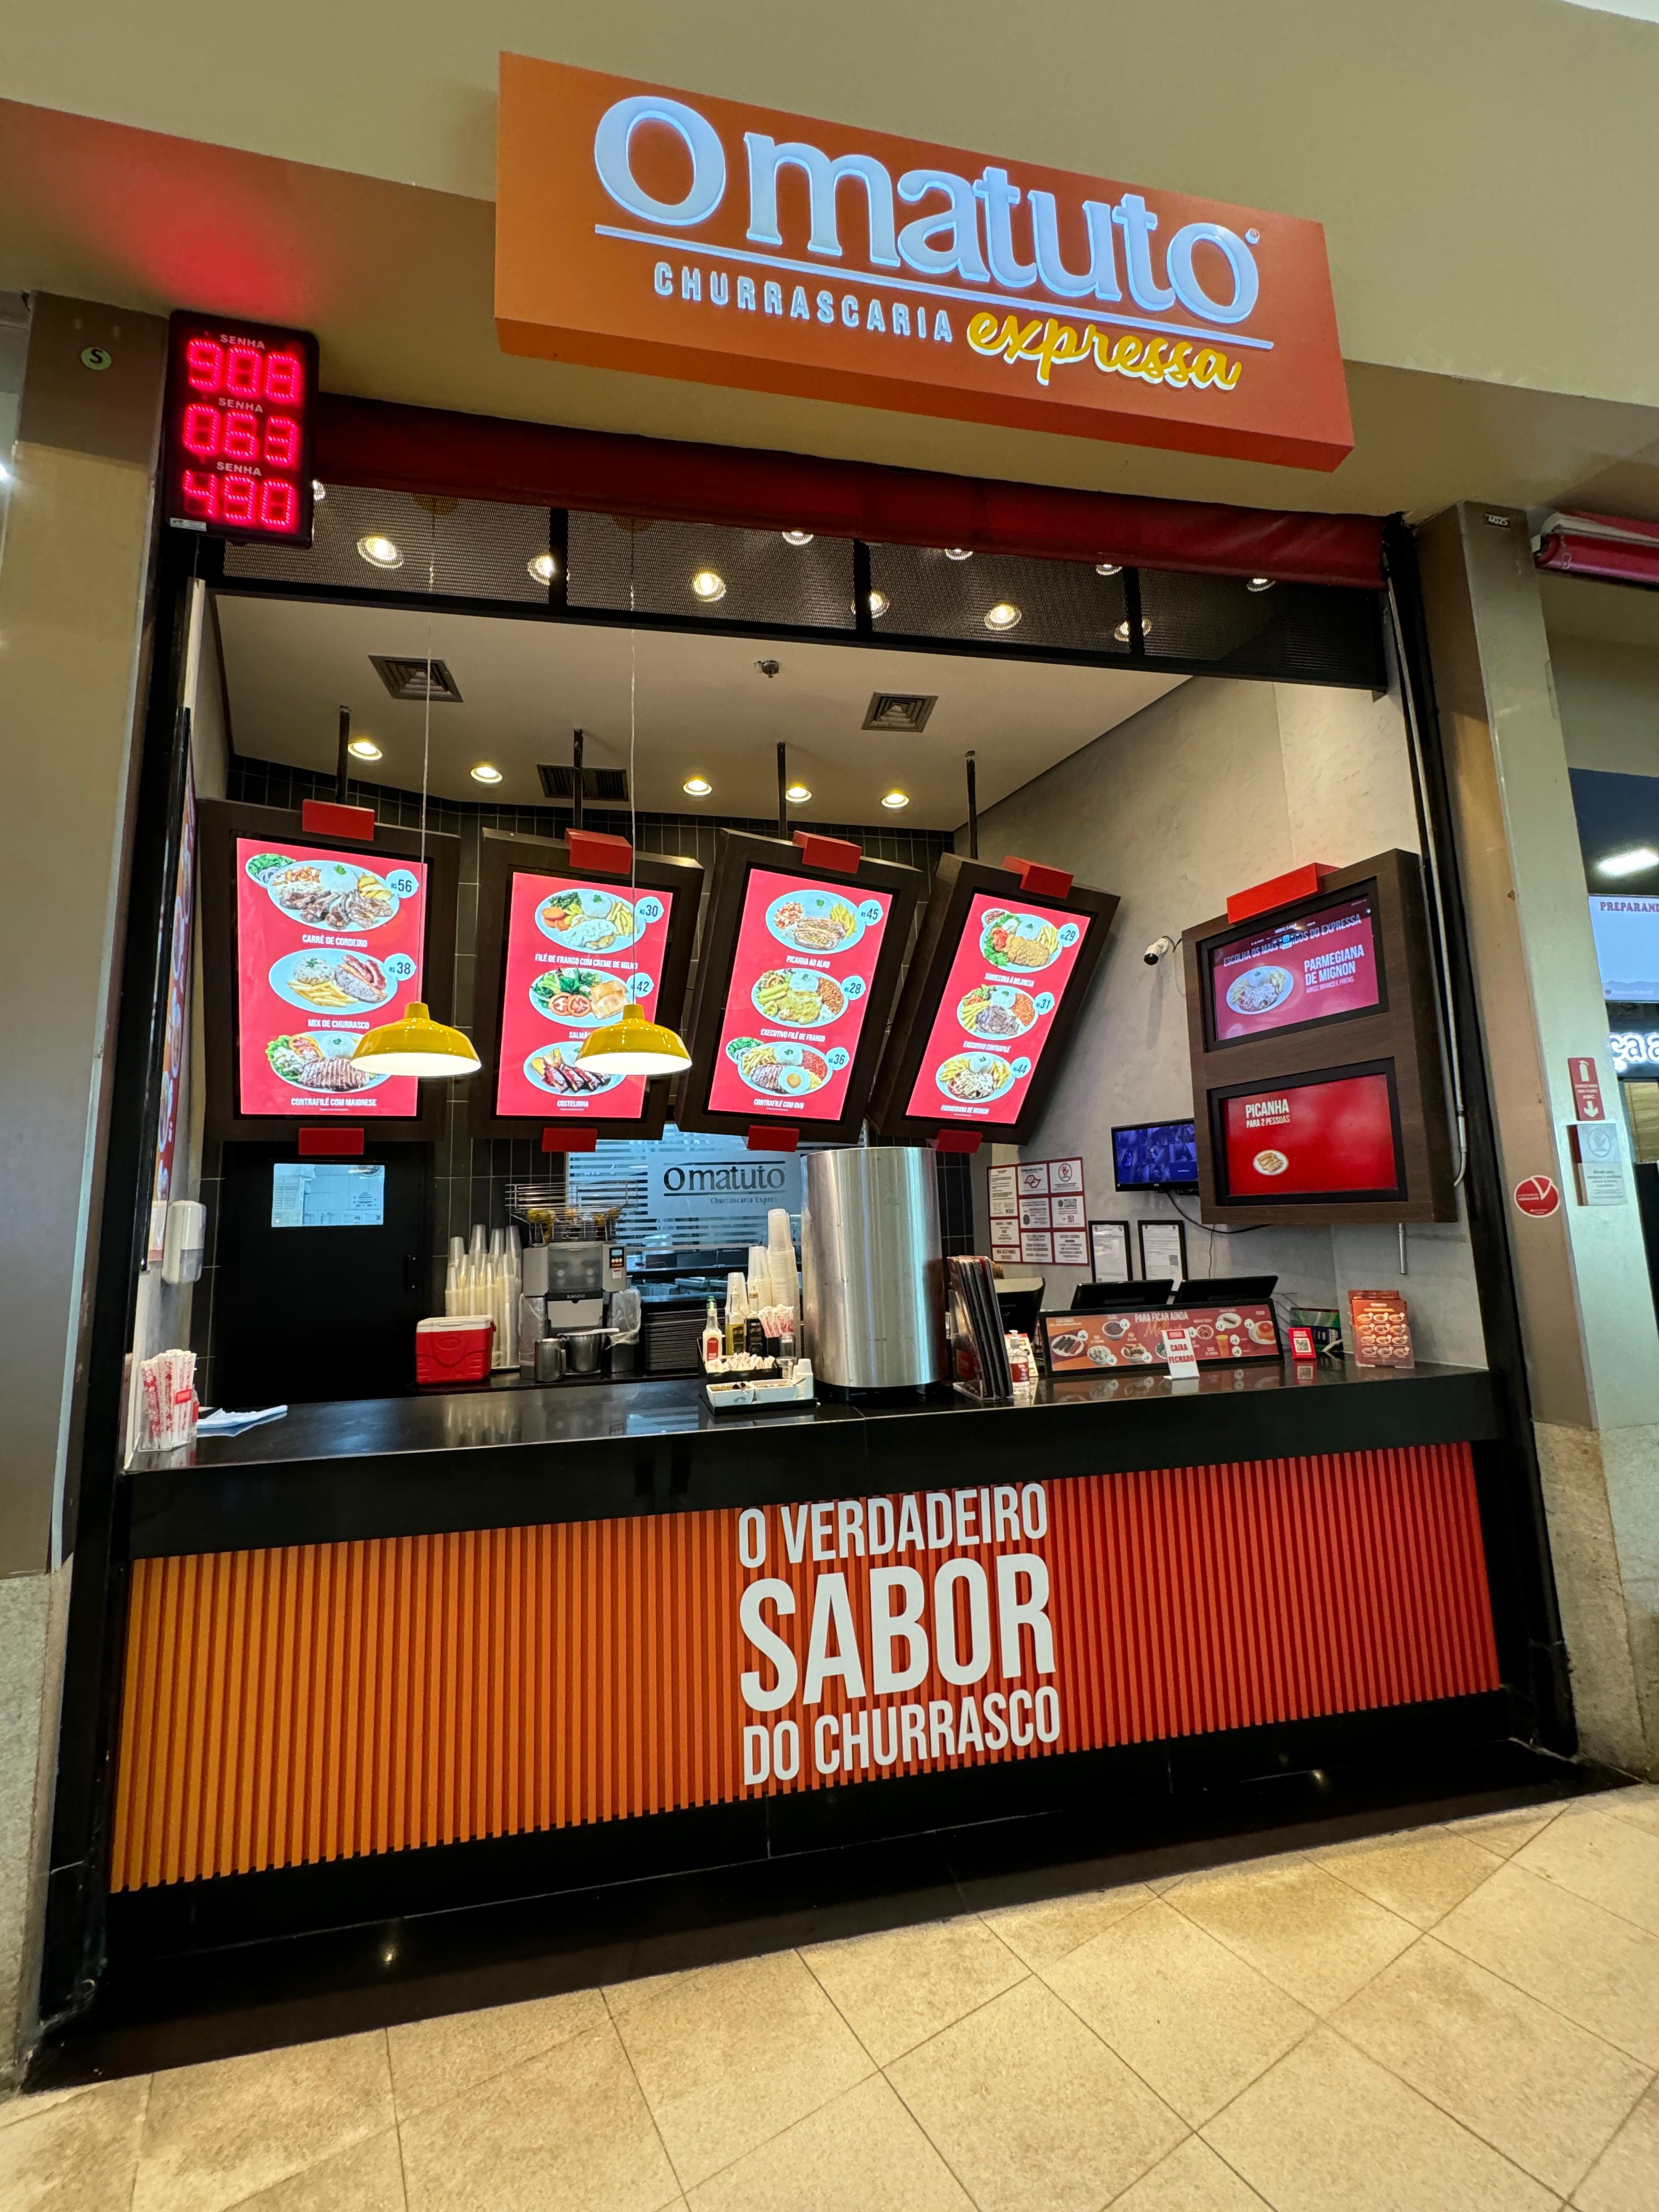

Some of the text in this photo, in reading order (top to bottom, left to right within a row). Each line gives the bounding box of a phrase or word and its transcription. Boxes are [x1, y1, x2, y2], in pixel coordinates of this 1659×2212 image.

[595, 96, 1259, 324] O matuto
[653, 262, 952, 342] CHURRASCARIA
[221, 334, 266, 349] SENHA
[90, 348, 103, 363] S
[968, 310, 1241, 390] expressa
[188, 339, 300, 400] 908
[218, 398, 263, 413] SENHA
[183, 404, 298, 465] 063
[216, 461, 262, 476] SENHA
[183, 470, 292, 526] 490
[398, 879, 412, 892] 56
[645, 905, 658, 917] 30
[866, 909, 878, 920] 45
[302, 934, 368, 947] CARRÉ DE CORDEIRO
[1064, 930, 1076, 941] 29
[1223, 949, 1251, 967] ESCOLHA
[1251, 947, 1260, 958] OS
[1261, 941, 1278, 955] MAIS
[1310, 927, 1319, 939] DO
[1321, 913, 1362, 936] EXPRESSA
[548, 955, 556, 963] DE
[557, 956, 579, 965] FRANGO
[580, 958, 592, 966] COM
[593, 959, 612, 968] CREME
[786, 955, 809, 966] PICANHA
[1304, 944, 1364, 972] PARMEGIANA
[397, 962, 411, 974] 38
[1305, 961, 1356, 986] DE MIGNON
[636, 981, 650, 992] 42
[850, 984, 862, 995] 28
[1040, 998, 1051, 1009] 31
[308, 1019, 370, 1029] MIX DE CHURRASCO
[833, 1054, 845, 1065] 36
[1017, 1064, 1027, 1074] 44
[291, 1097, 329, 1106] CONTRAFILÉ
[1245, 1099, 1289, 1119] PICANHA
[1246, 1115, 1290, 1128] PARA 2 PESSOAS
[663, 1165, 786, 1191] O matuto
[1135, 1313, 1150, 1323] PARA
[1152, 1312, 1170, 1322] FICAR
[1170, 1311, 1189, 1321] AINDA
[1170, 1344, 1188, 1352] CAIXA
[1169, 1355, 1195, 1364] FECHADO
[738, 1482, 1048, 1568] O VERDADEIRO
[740, 1553, 1057, 1712] SABOR
[743, 1686, 1060, 1786] DO CHURRASCO
